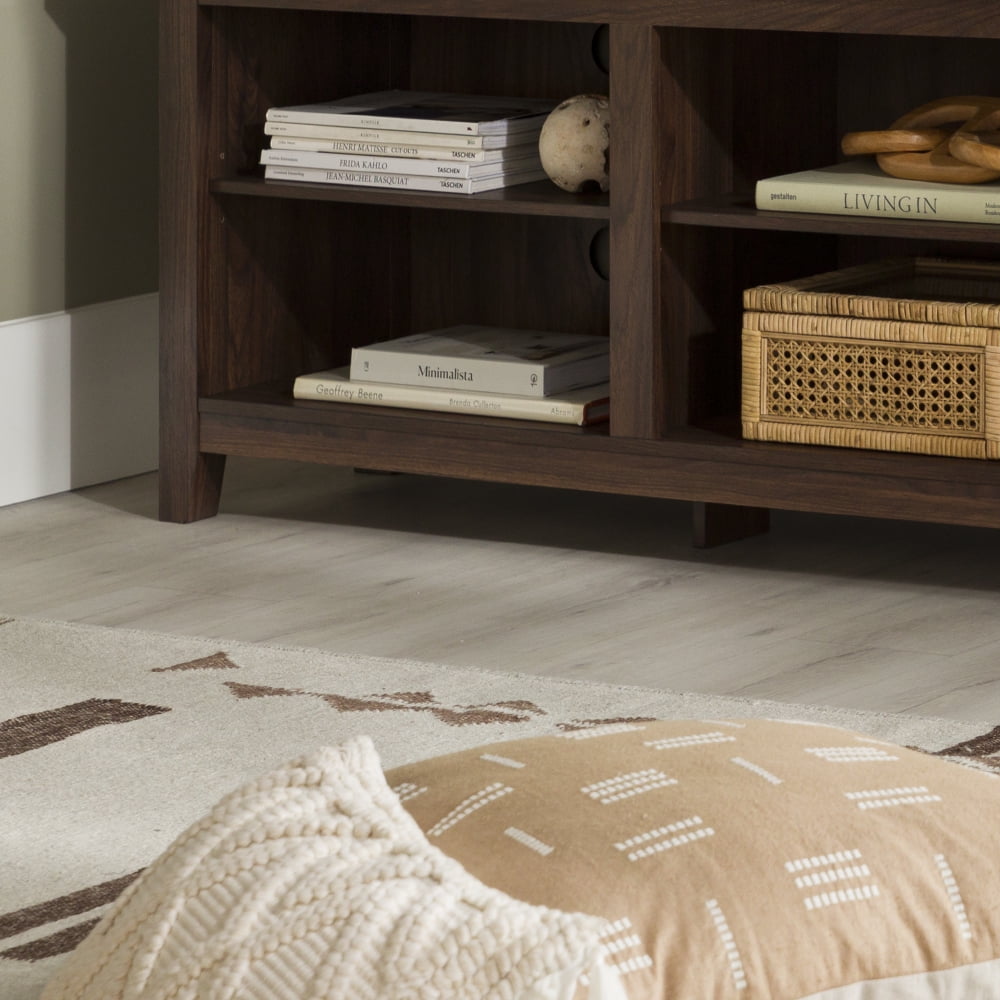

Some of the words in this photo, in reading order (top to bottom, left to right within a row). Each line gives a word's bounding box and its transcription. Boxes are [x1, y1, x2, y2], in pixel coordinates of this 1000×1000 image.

[333, 141, 356, 151] HENRI
[358, 143, 387, 153] MATISSE
[451, 151, 476, 159] TASCHEN
[339, 159, 360, 168] FRIDA
[362, 161, 388, 170] KAHLO
[326, 172, 372, 183] JEAN-MICHEL
[374, 175, 409, 185] BASQUIAT
[440, 181, 464, 189] TASCHEN
[770, 192, 797, 201] gestalten
[418, 365, 473, 381] Minimalista
[316, 384, 354, 400] Geoffrey
[358, 388, 383, 400] Beene
